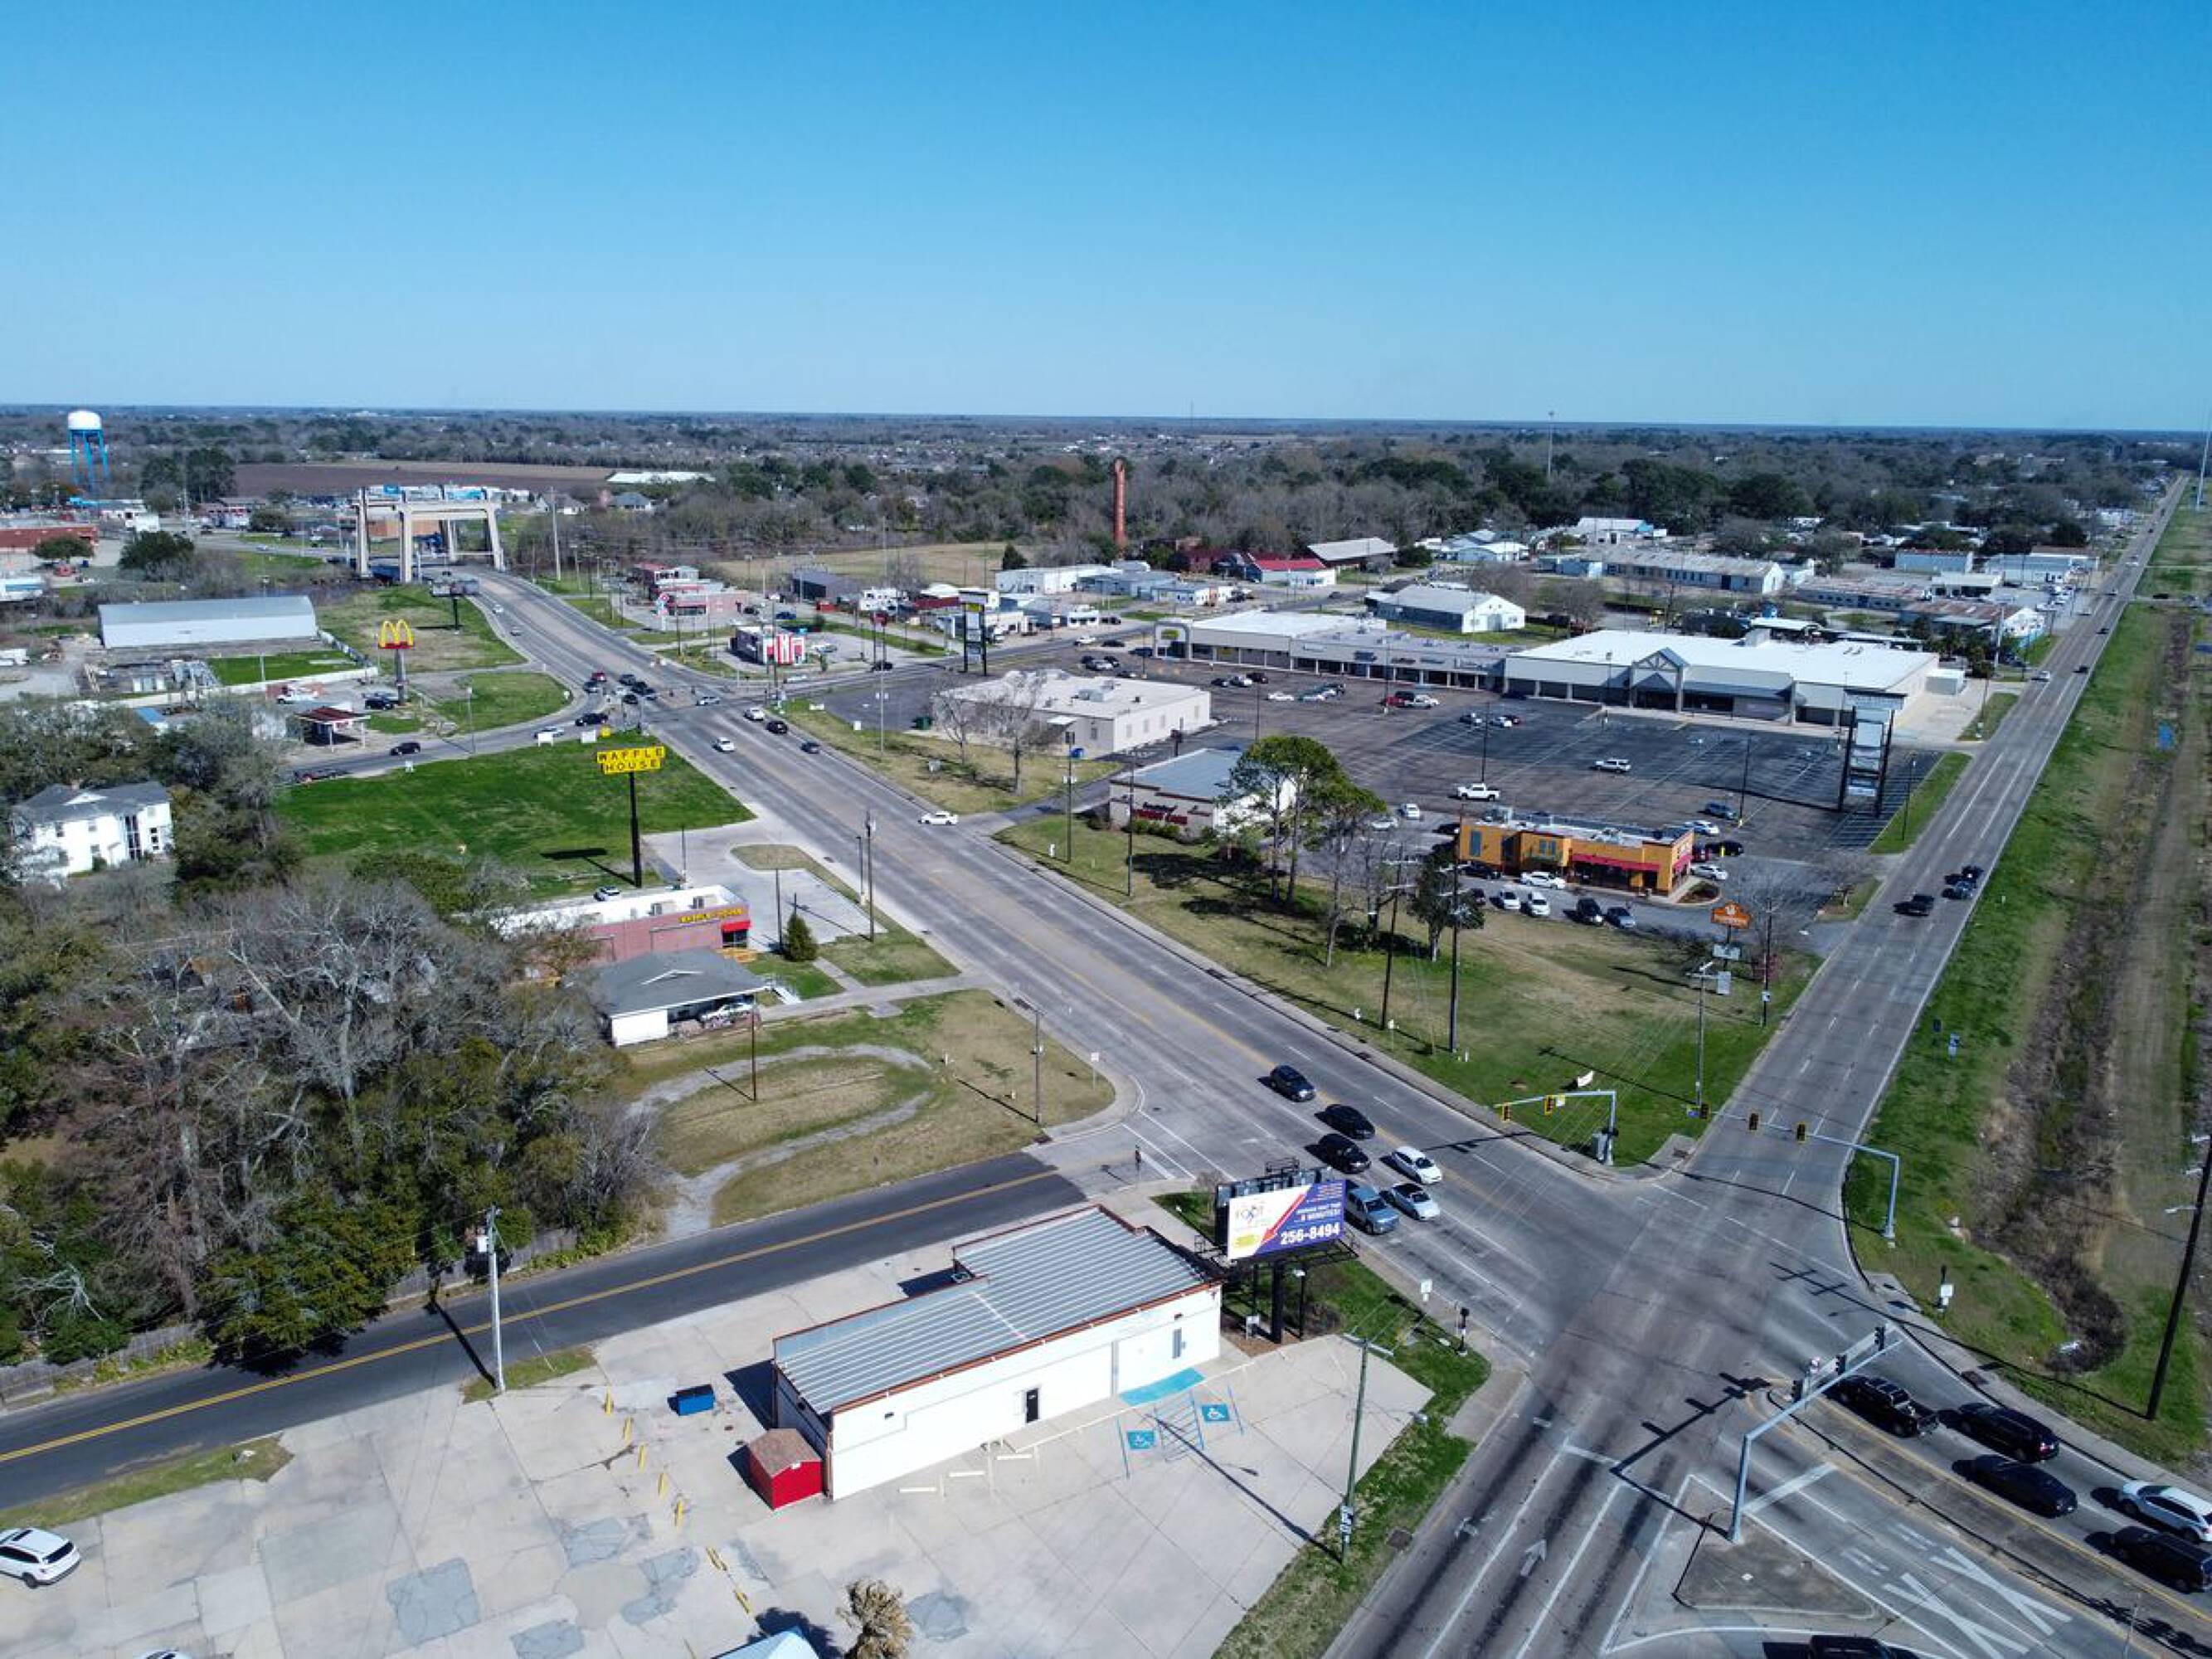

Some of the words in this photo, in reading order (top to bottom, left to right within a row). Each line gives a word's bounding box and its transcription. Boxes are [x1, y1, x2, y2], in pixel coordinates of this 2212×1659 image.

[599, 748, 663, 761] WAFFLE
[606, 759, 657, 771] HOUSE
[1280, 1223, 1339, 1245] 256-8494
